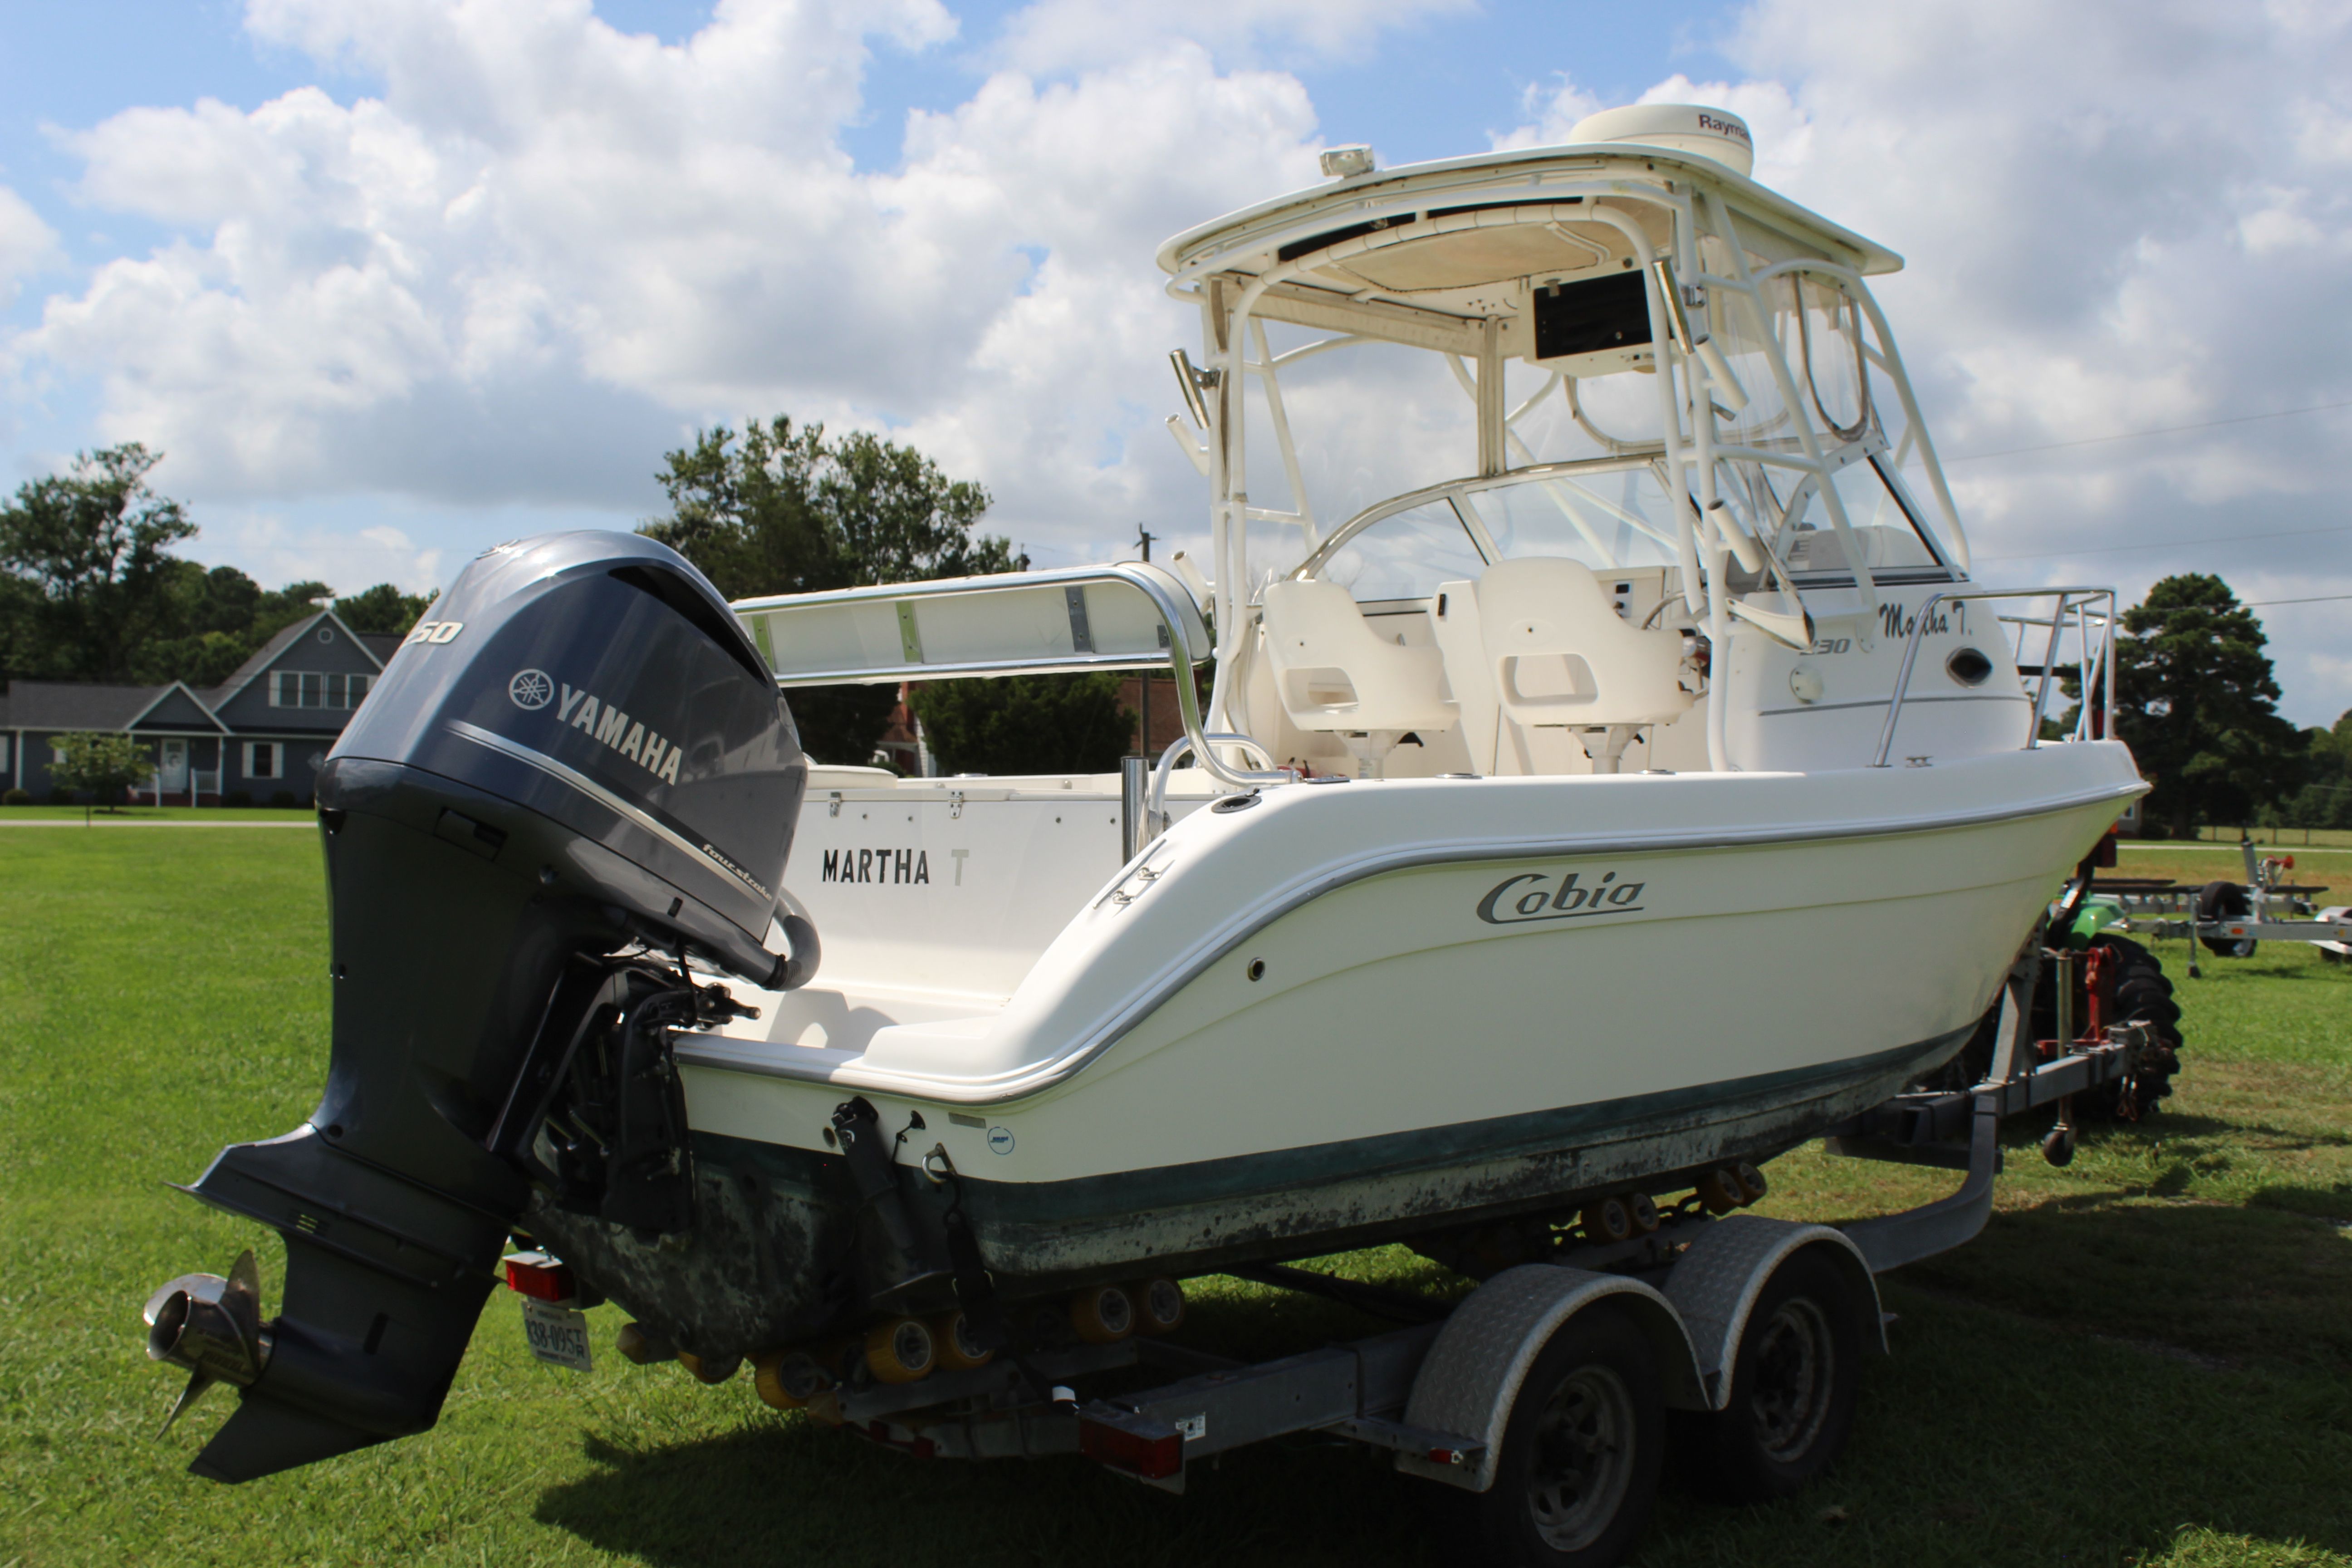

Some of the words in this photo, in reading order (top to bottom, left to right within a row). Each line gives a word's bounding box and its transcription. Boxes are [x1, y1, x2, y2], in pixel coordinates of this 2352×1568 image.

[556, 683, 682, 786] YAMAHA
[823, 849, 929, 884] MARTHA
[951, 849, 970, 886] T
[1476, 872, 1646, 924] Cobia
